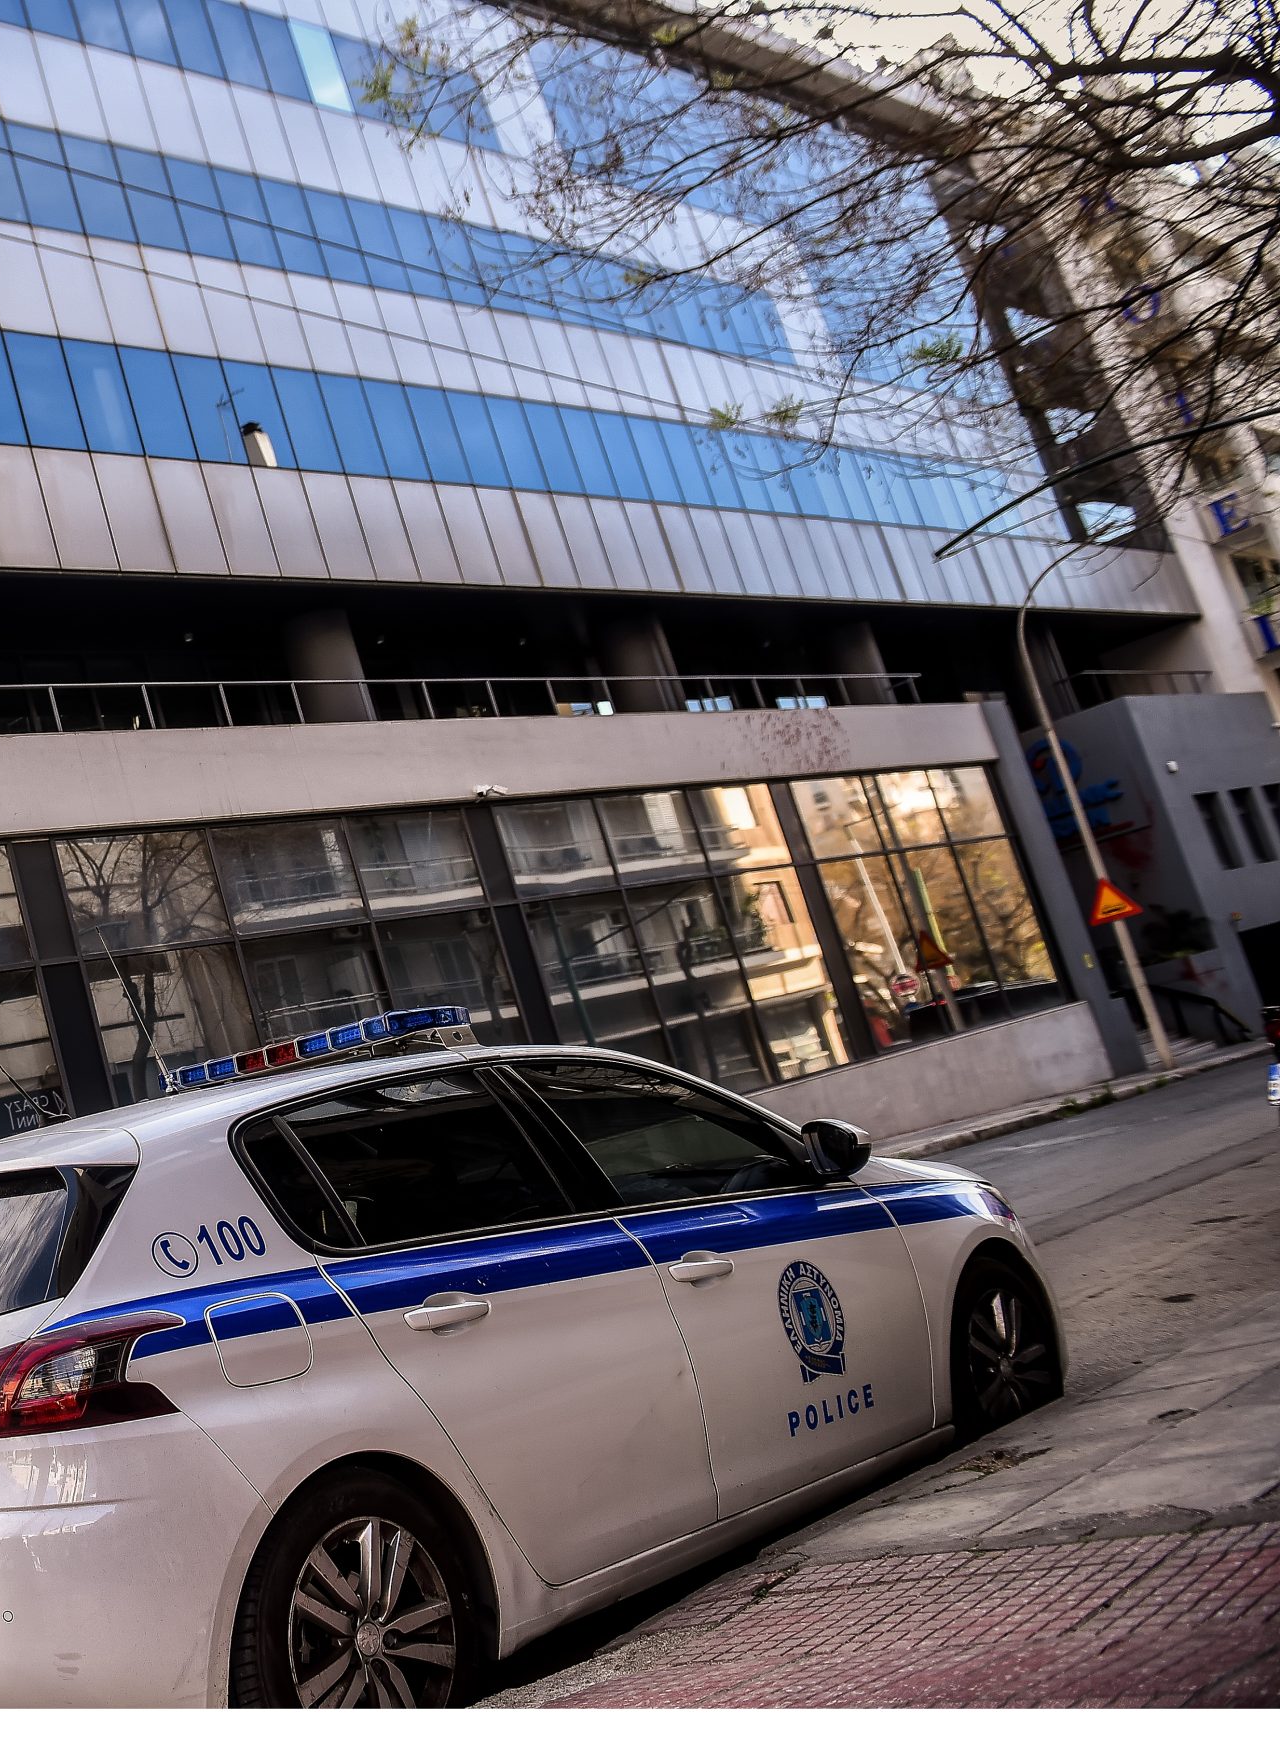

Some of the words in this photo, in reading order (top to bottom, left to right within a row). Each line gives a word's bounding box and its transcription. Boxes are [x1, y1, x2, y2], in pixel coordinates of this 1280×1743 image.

[197, 1215, 266, 1265] 100
[800, 1263, 844, 1341] ΑΣΤΥΝΟΜΙΑ
[787, 1383, 875, 1437] POLICE
